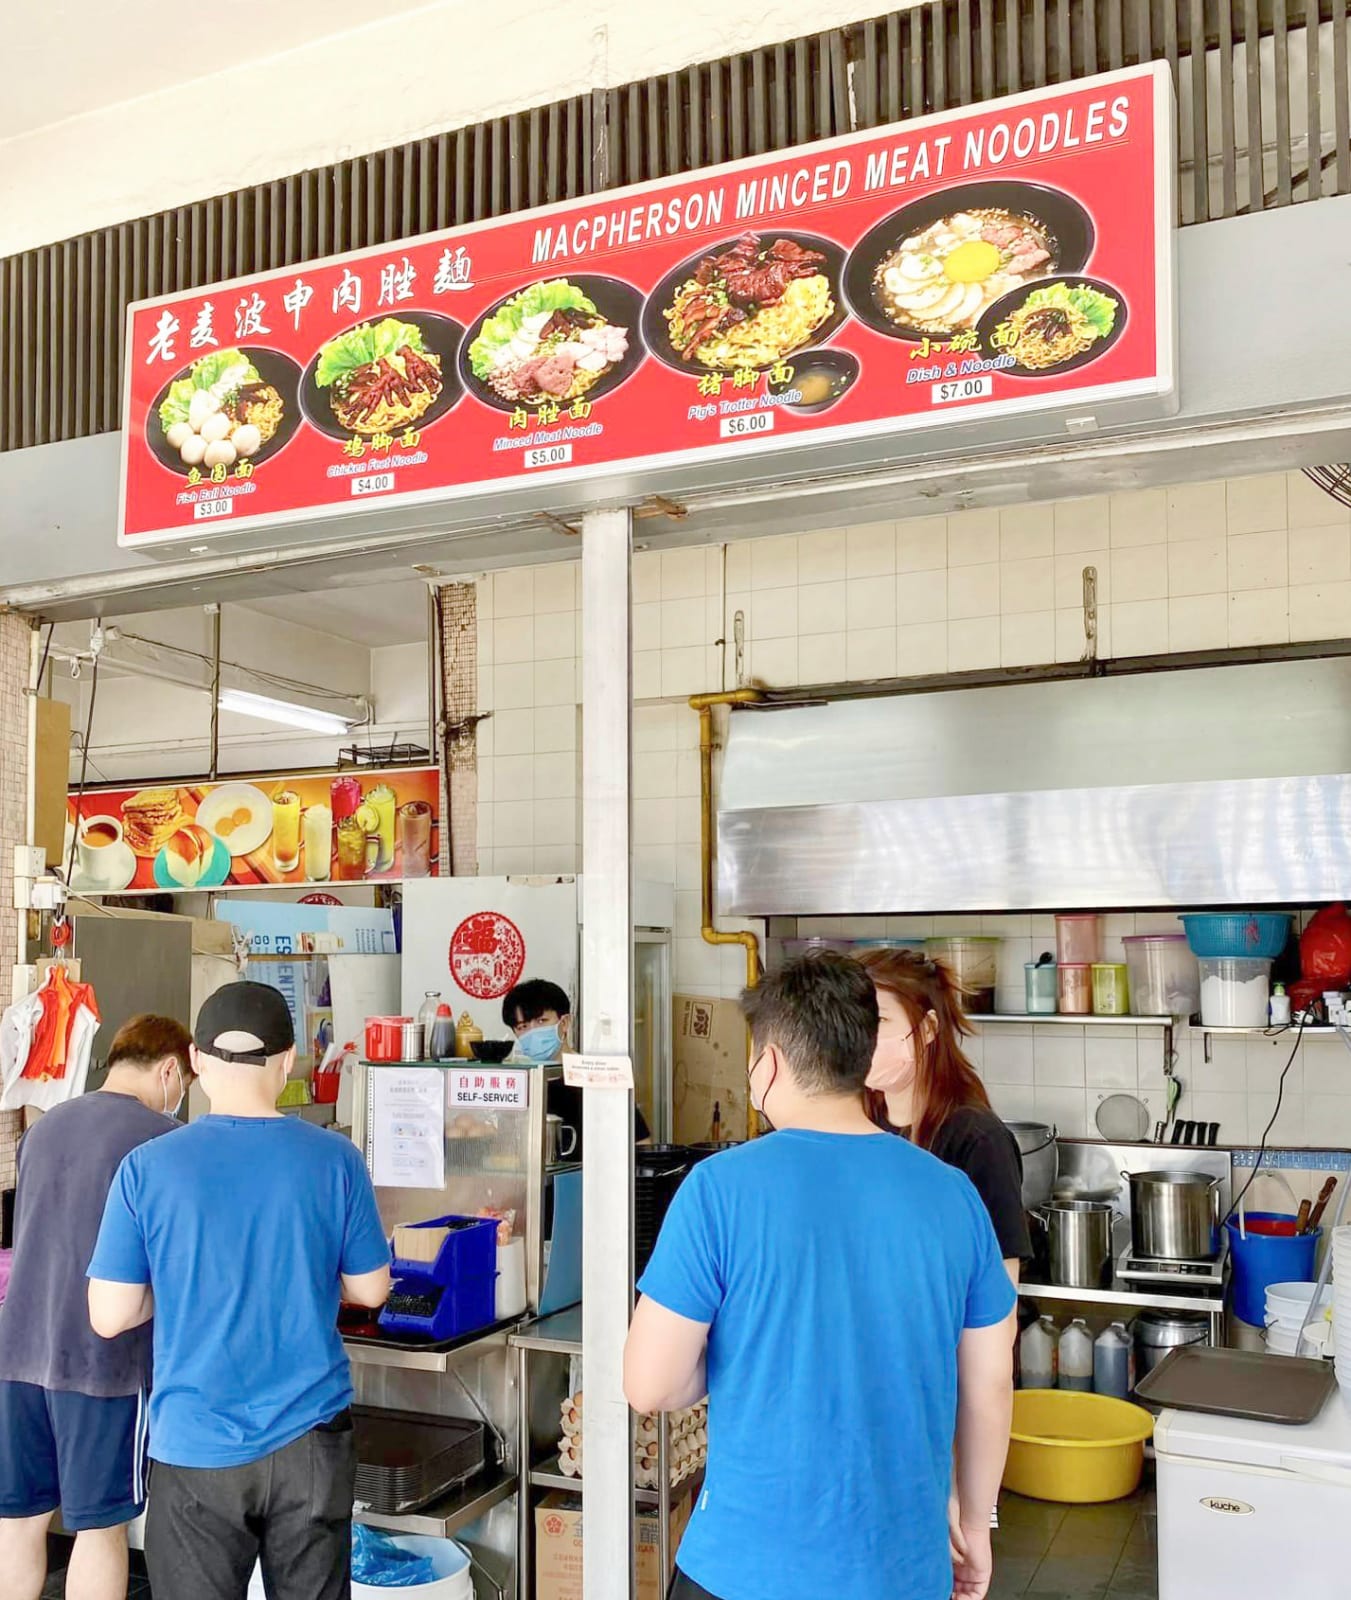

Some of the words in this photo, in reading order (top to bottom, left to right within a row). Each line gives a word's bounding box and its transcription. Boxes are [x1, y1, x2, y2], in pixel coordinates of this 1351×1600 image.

[531, 189, 724, 264] MACPHERSON
[736, 159, 852, 219] MINCED
[864, 136, 952, 191] MEAT
[963, 96, 1130, 170] NOODLES
[909, 322, 1021, 360] 小碗面
[697, 360, 795, 397] 猪脚面
[907, 366, 941, 383] Dish
[945, 362, 957, 377] &
[961, 355, 1016, 374] Noodle
[940, 379, 983, 400] $7.00
[509, 396, 592, 430] 肉脞面
[688, 403, 716, 420] Pig's
[720, 398, 757, 413] Trotter
[760, 388, 802, 407] Noodle
[493, 433, 533, 451] Minced
[534, 428, 561, 444] Meat
[562, 422, 603, 440] Noodle
[728, 415, 767, 434] $6.00
[342, 427, 421, 458] 鸡脚面
[327, 462, 367, 477] Chicken
[368, 457, 391, 471] Feet
[391, 451, 428, 467] Noodle
[531, 447, 566, 465] $5.00
[177, 491, 198, 504] Fish
[199, 487, 220, 501] Ball
[220, 482, 256, 497] Noodle
[358, 476, 389, 492] $4.00
[200, 500, 228, 516] $3.00
[457, 1092, 519, 1103] SELF-SERVICE
[1210, 1500, 1241, 1512] kuche
